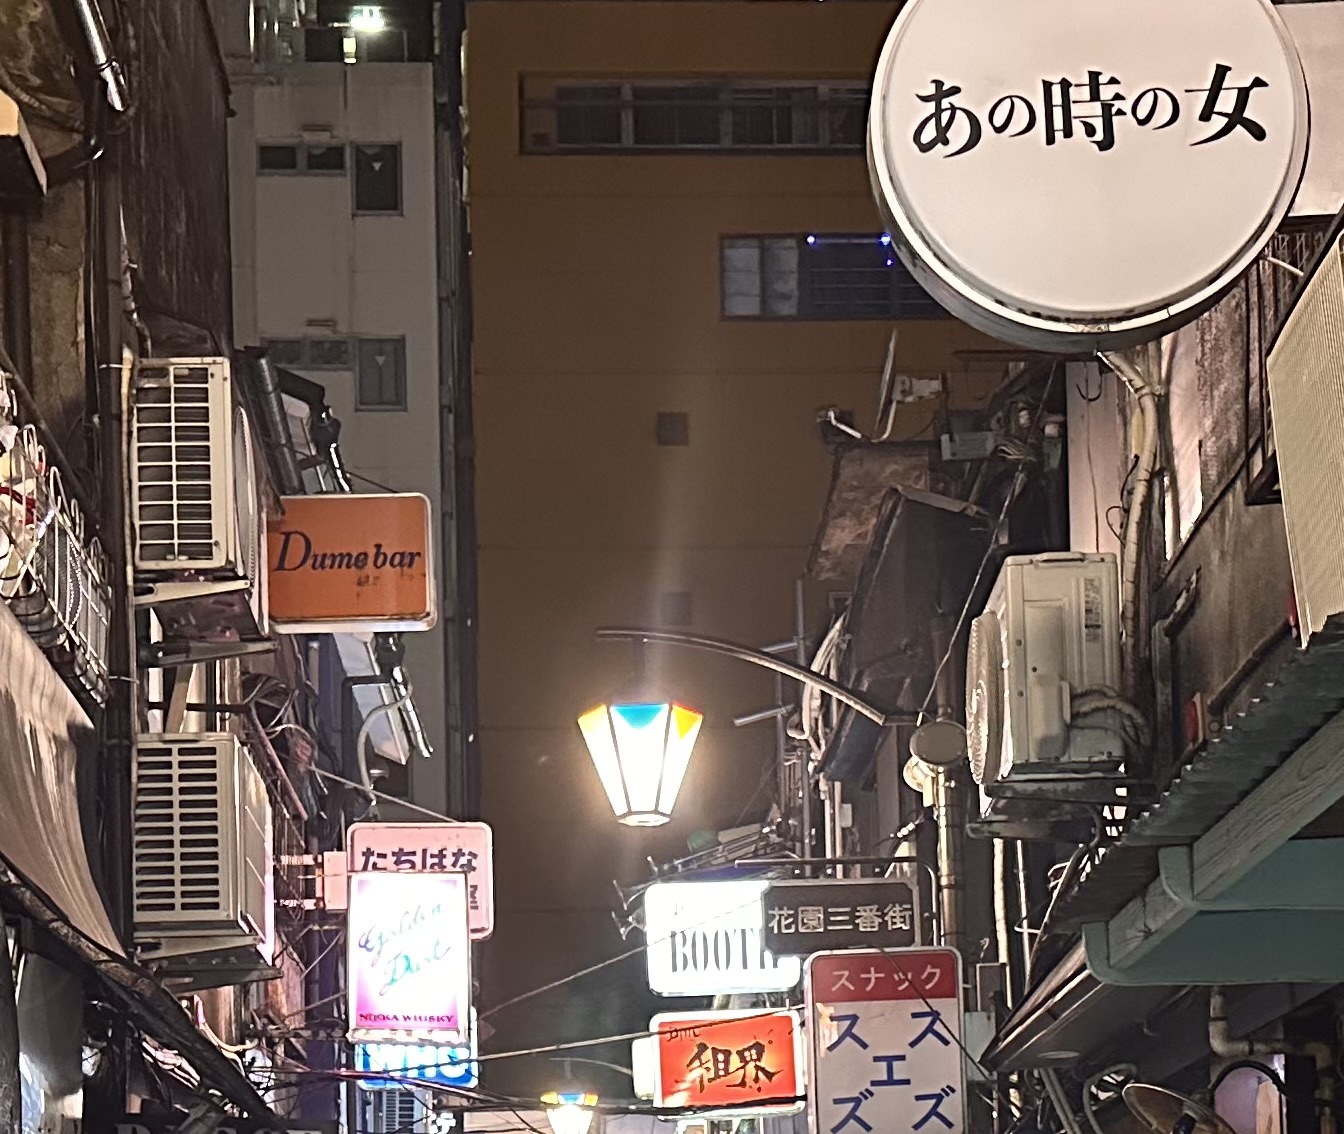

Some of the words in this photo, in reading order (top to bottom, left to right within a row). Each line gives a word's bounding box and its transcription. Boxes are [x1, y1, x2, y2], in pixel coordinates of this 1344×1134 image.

[913, 64, 1270, 157] あの時の女
[372, 544, 422, 570] bar
[767, 903, 912, 934] 花園三番街
[831, 964, 941, 992] スナック
